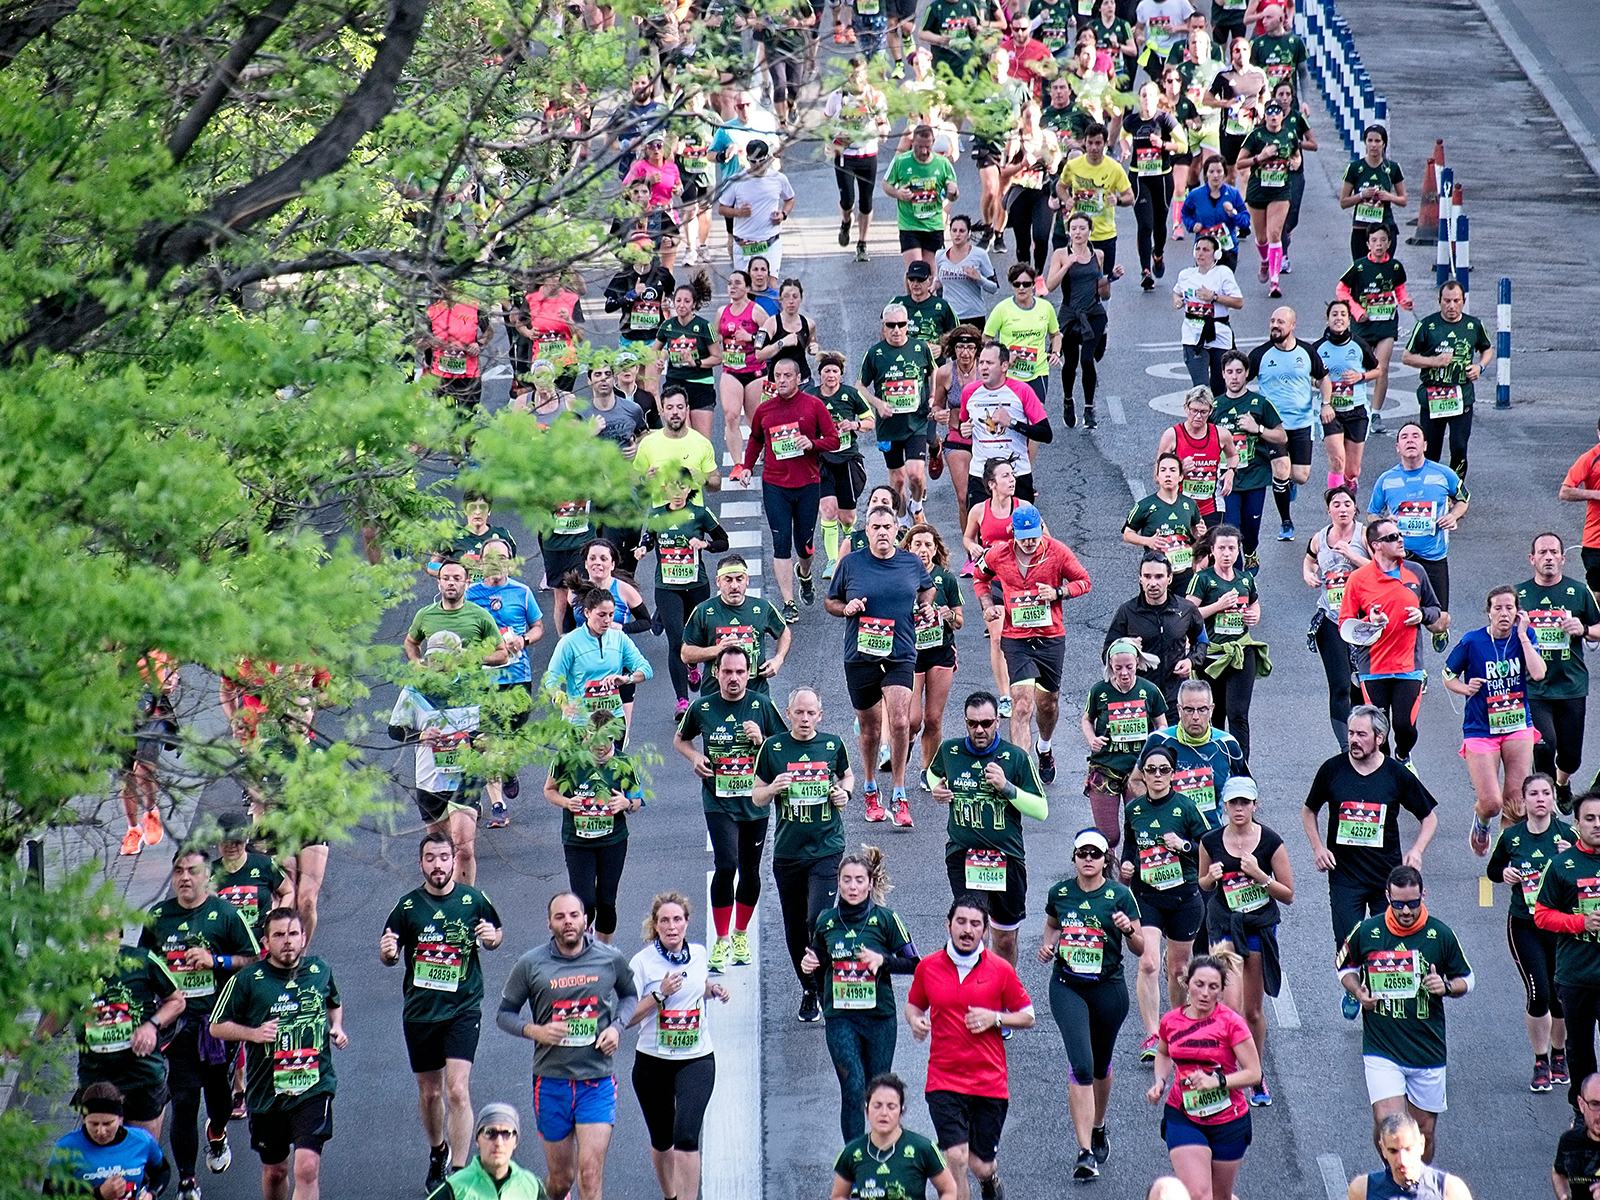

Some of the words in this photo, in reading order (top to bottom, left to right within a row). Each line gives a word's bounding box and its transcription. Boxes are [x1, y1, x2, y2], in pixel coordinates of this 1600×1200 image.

[1192, 459, 1217, 467] NMARK
[1487, 679, 1505, 690] FOR
[1506, 676, 1521, 687] THE
[953, 780, 978, 788] MADRID
[801, 786, 821, 796] 41756
[1350, 827, 1371, 837] 42572
[978, 870, 998, 881] 41644
[1149, 873, 1154, 883] F
[1154, 869, 1175, 882] 40694
[1235, 894, 1240, 905] F
[1241, 888, 1261, 903] 40897
[1061, 920, 1084, 928] MADRID
[418, 934, 443, 943] MADRID
[831, 949, 852, 959] MADRID
[1073, 951, 1095, 963] 40834
[428, 968, 450, 980] 42859
[183, 975, 205, 987] 42384
[1384, 977, 1406, 989] 42659
[841, 987, 845, 998] F
[846, 987, 867, 998] 41987
[270, 1002, 299, 1013] MADRID
[102, 1029, 125, 1042] 40821
[667, 1035, 671, 1046] F
[672, 1035, 694, 1046] 41439
[288, 1075, 311, 1086] 41500
[1193, 1095, 1197, 1107] F
[1198, 1091, 1221, 1106] 40951
[860, 1188, 885, 1198] MADRID
